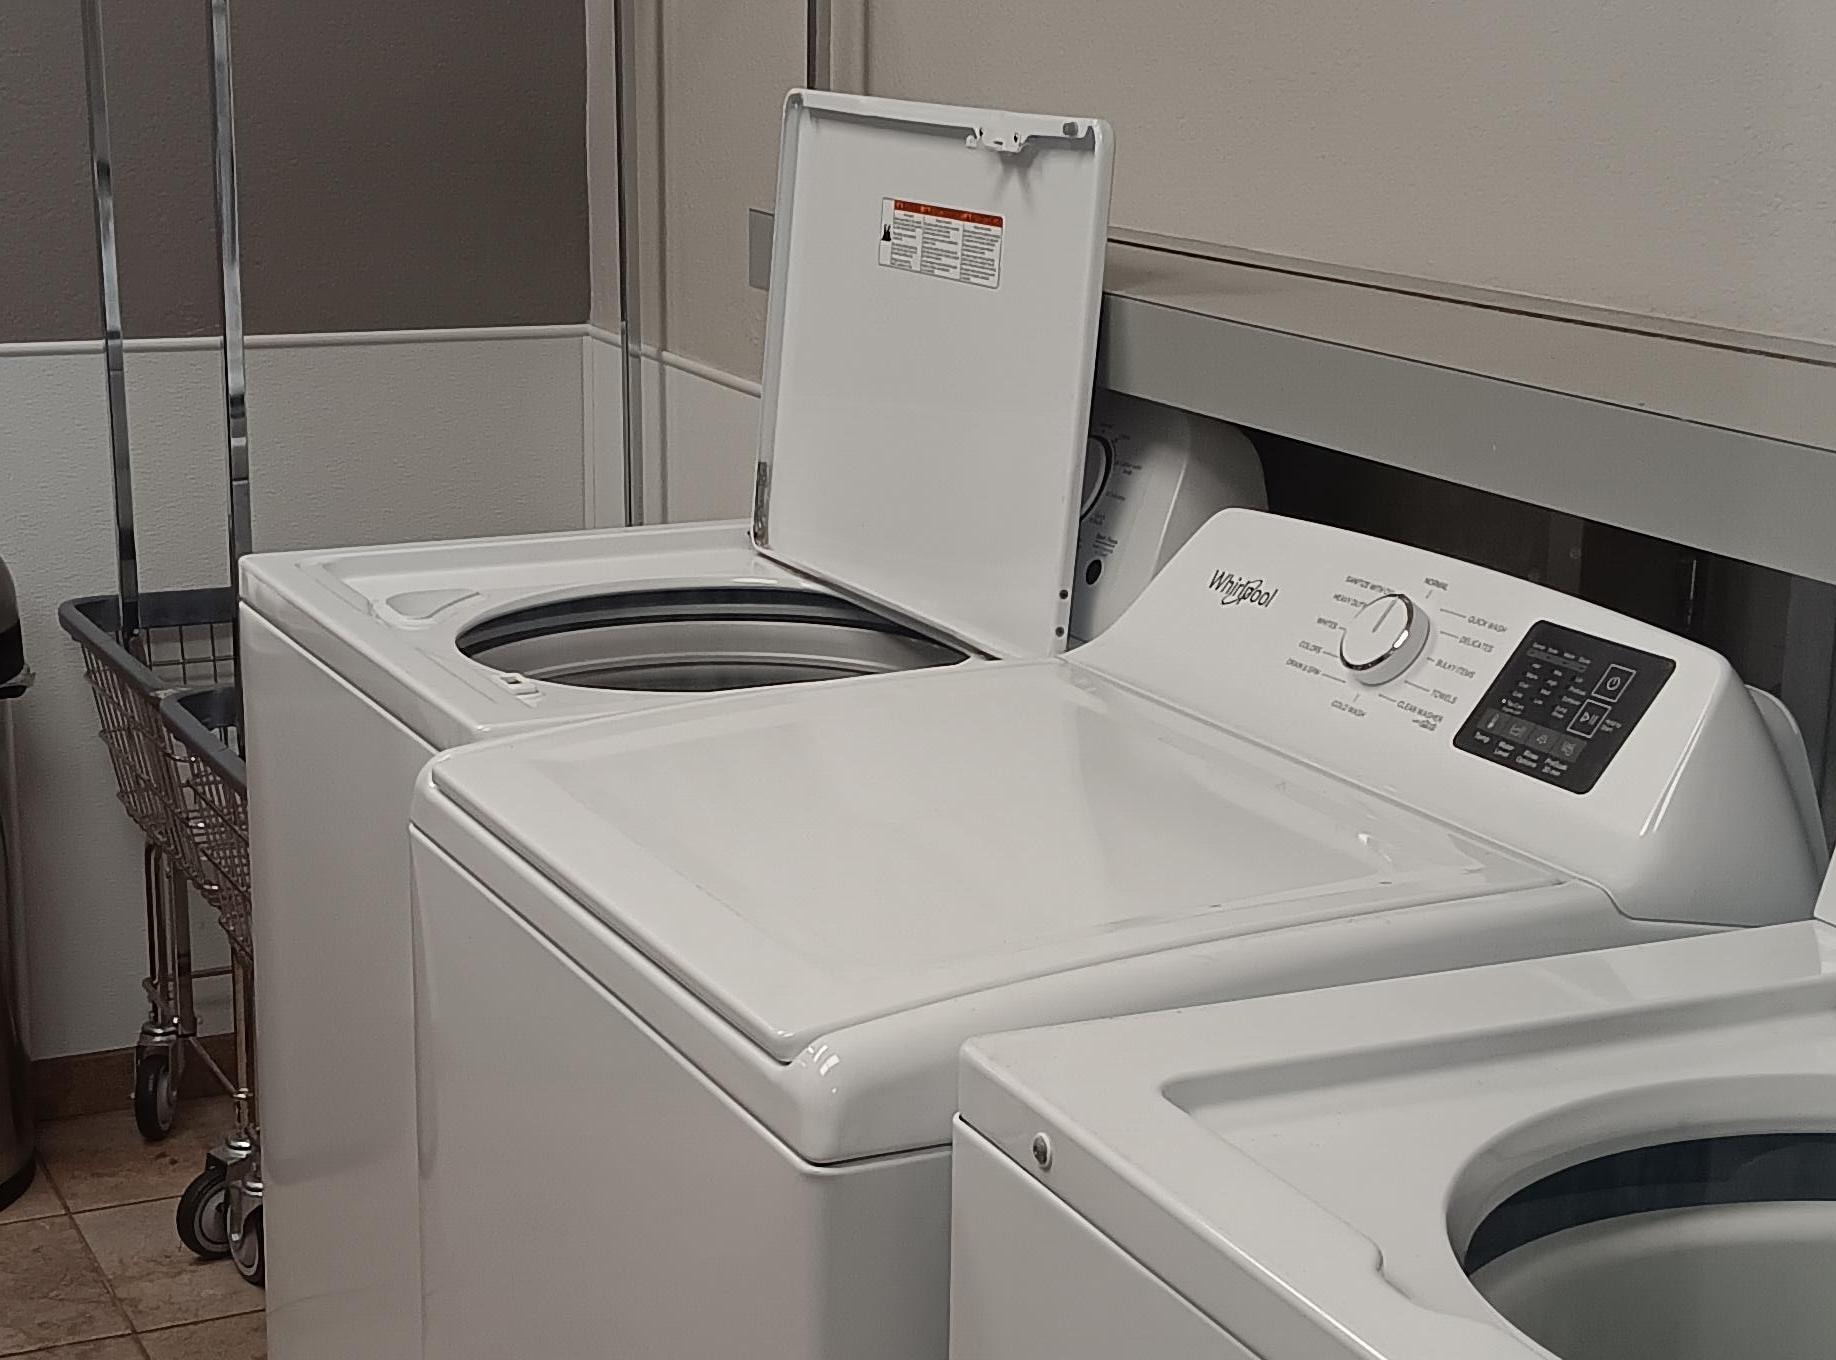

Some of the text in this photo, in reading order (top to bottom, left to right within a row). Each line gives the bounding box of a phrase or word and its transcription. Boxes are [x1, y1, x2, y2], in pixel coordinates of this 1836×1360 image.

[1208, 569, 1279, 608] Whirlpool
[1424, 576, 1449, 591] NORMAL
[1467, 615, 1508, 633] QUICK WASH
[1298, 640, 1323, 655] COLORS
[1459, 635, 1495, 654] DELICATES
[1435, 658, 1456, 671] BULKY
[1430, 689, 1458, 705] TOWELS
[1396, 700, 1444, 723] CLEAN WASHER
